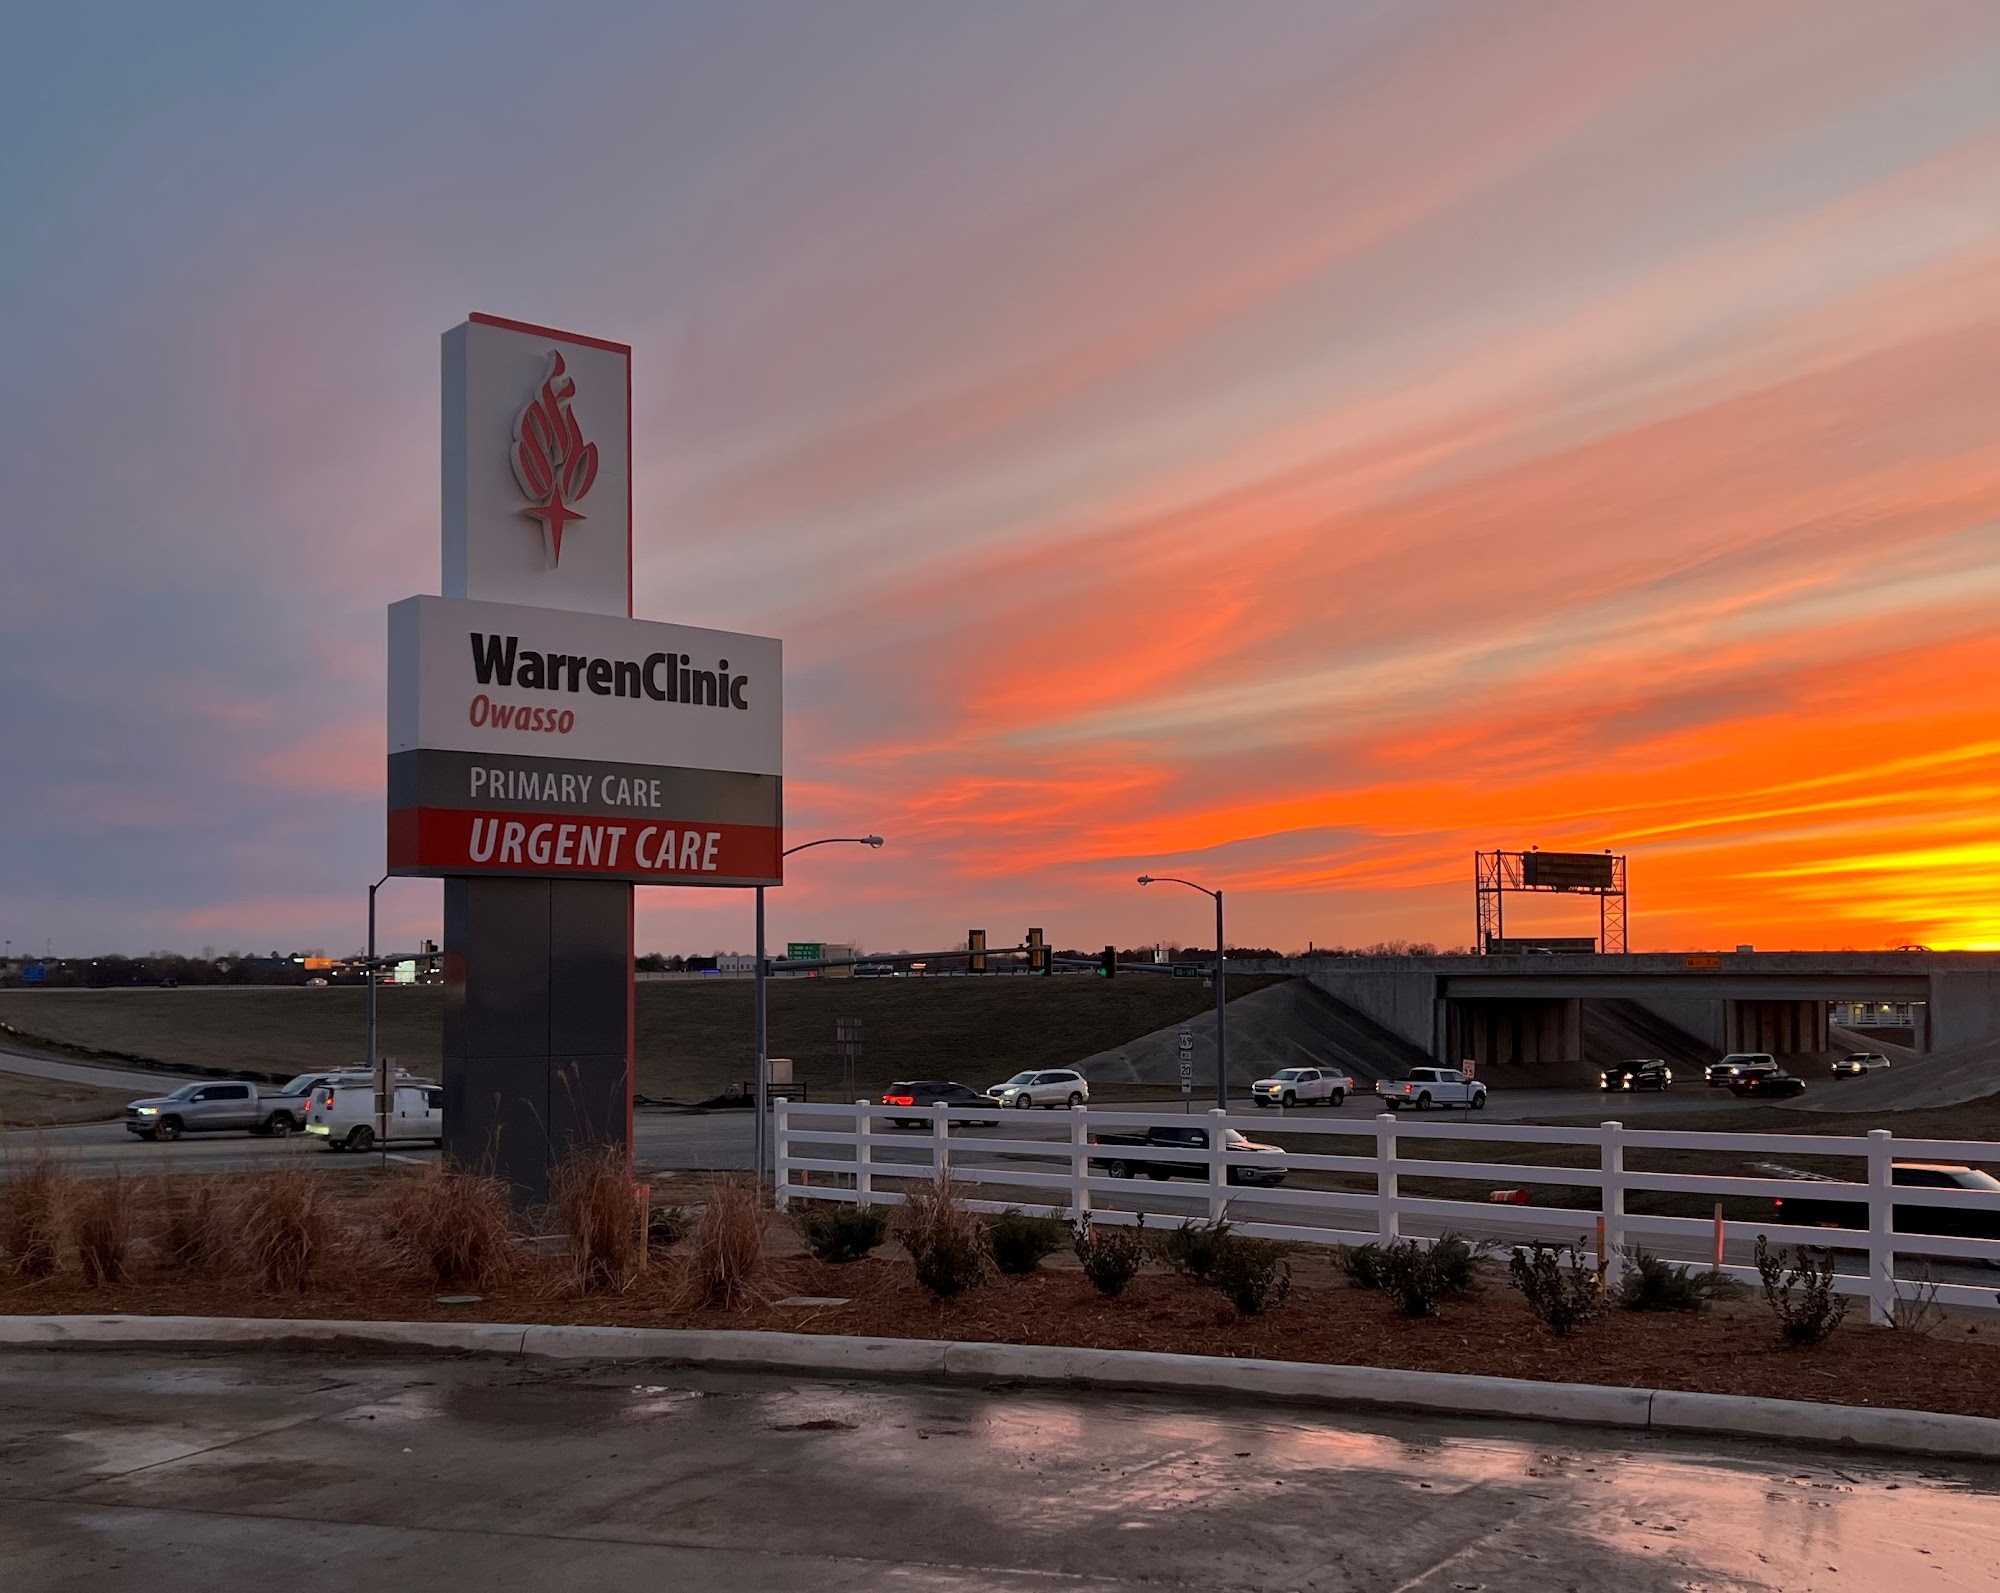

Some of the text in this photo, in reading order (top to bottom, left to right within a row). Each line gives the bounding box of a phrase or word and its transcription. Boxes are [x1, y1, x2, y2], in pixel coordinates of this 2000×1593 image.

[470, 632, 748, 710] WarrenClinic
[469, 694, 575, 734] Owasso
[470, 766, 662, 808] PRIMARY CARE
[469, 818, 721, 871] URGENT CARE
[1179, 1036, 1192, 1047] 169
[1181, 1066, 1191, 1076] 20
